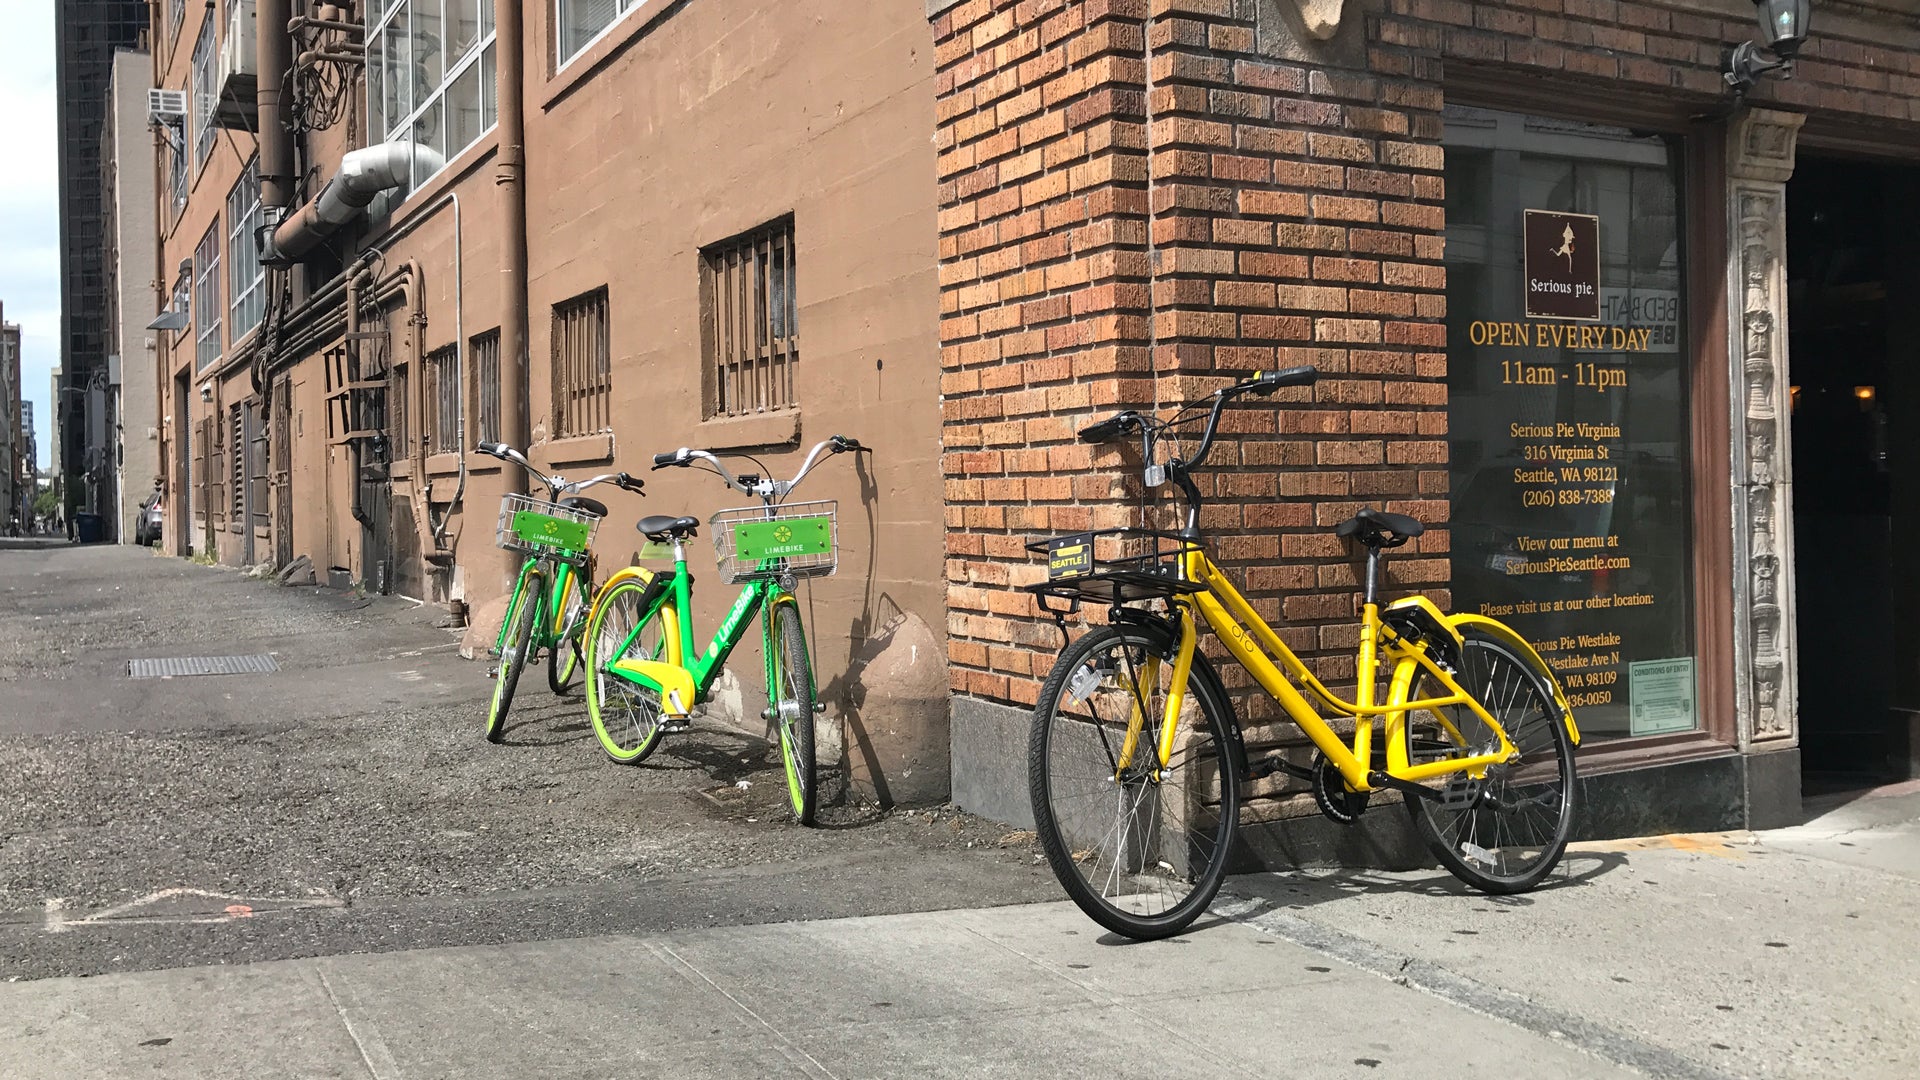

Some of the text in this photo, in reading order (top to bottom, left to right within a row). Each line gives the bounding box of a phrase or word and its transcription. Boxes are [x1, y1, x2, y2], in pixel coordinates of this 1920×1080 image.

[1531, 279, 1594, 298] Serious pie.
[1469, 320, 1652, 352] OPEN EVERY DAY
[1502, 360, 1556, 385] 11am
[1576, 362, 1627, 393] 11pm
[1510, 422, 1621, 441] Serious Pie Virginia
[1524, 445, 1609, 463] 316 Virginia St
[1514, 467, 1618, 485] Seattle, WA 98121
[1523, 489, 1612, 507] (206) 838-7388
[533, 533, 564, 545] LIMEBIKE
[1517, 534, 1619, 551] View our menu at
[765, 544, 804, 555] LIMEBIKE
[1051, 556, 1082, 569] SEATTLE
[1506, 555, 1630, 576] SeriousPieSeattle.com
[717, 585, 755, 643] LimeBike
[1480, 593, 1654, 617] Please visit us at our other location:
[1531, 632, 1621, 652] rious Pie Westlake
[1591, 653, 1609, 667] Ave
[1611, 652, 1620, 665] N
[1566, 675, 1585, 688] WA
[1586, 671, 1617, 687] 98109
[1634, 666, 1665, 676] CONDITIONS
[1674, 665, 1689, 673] ENTRY
